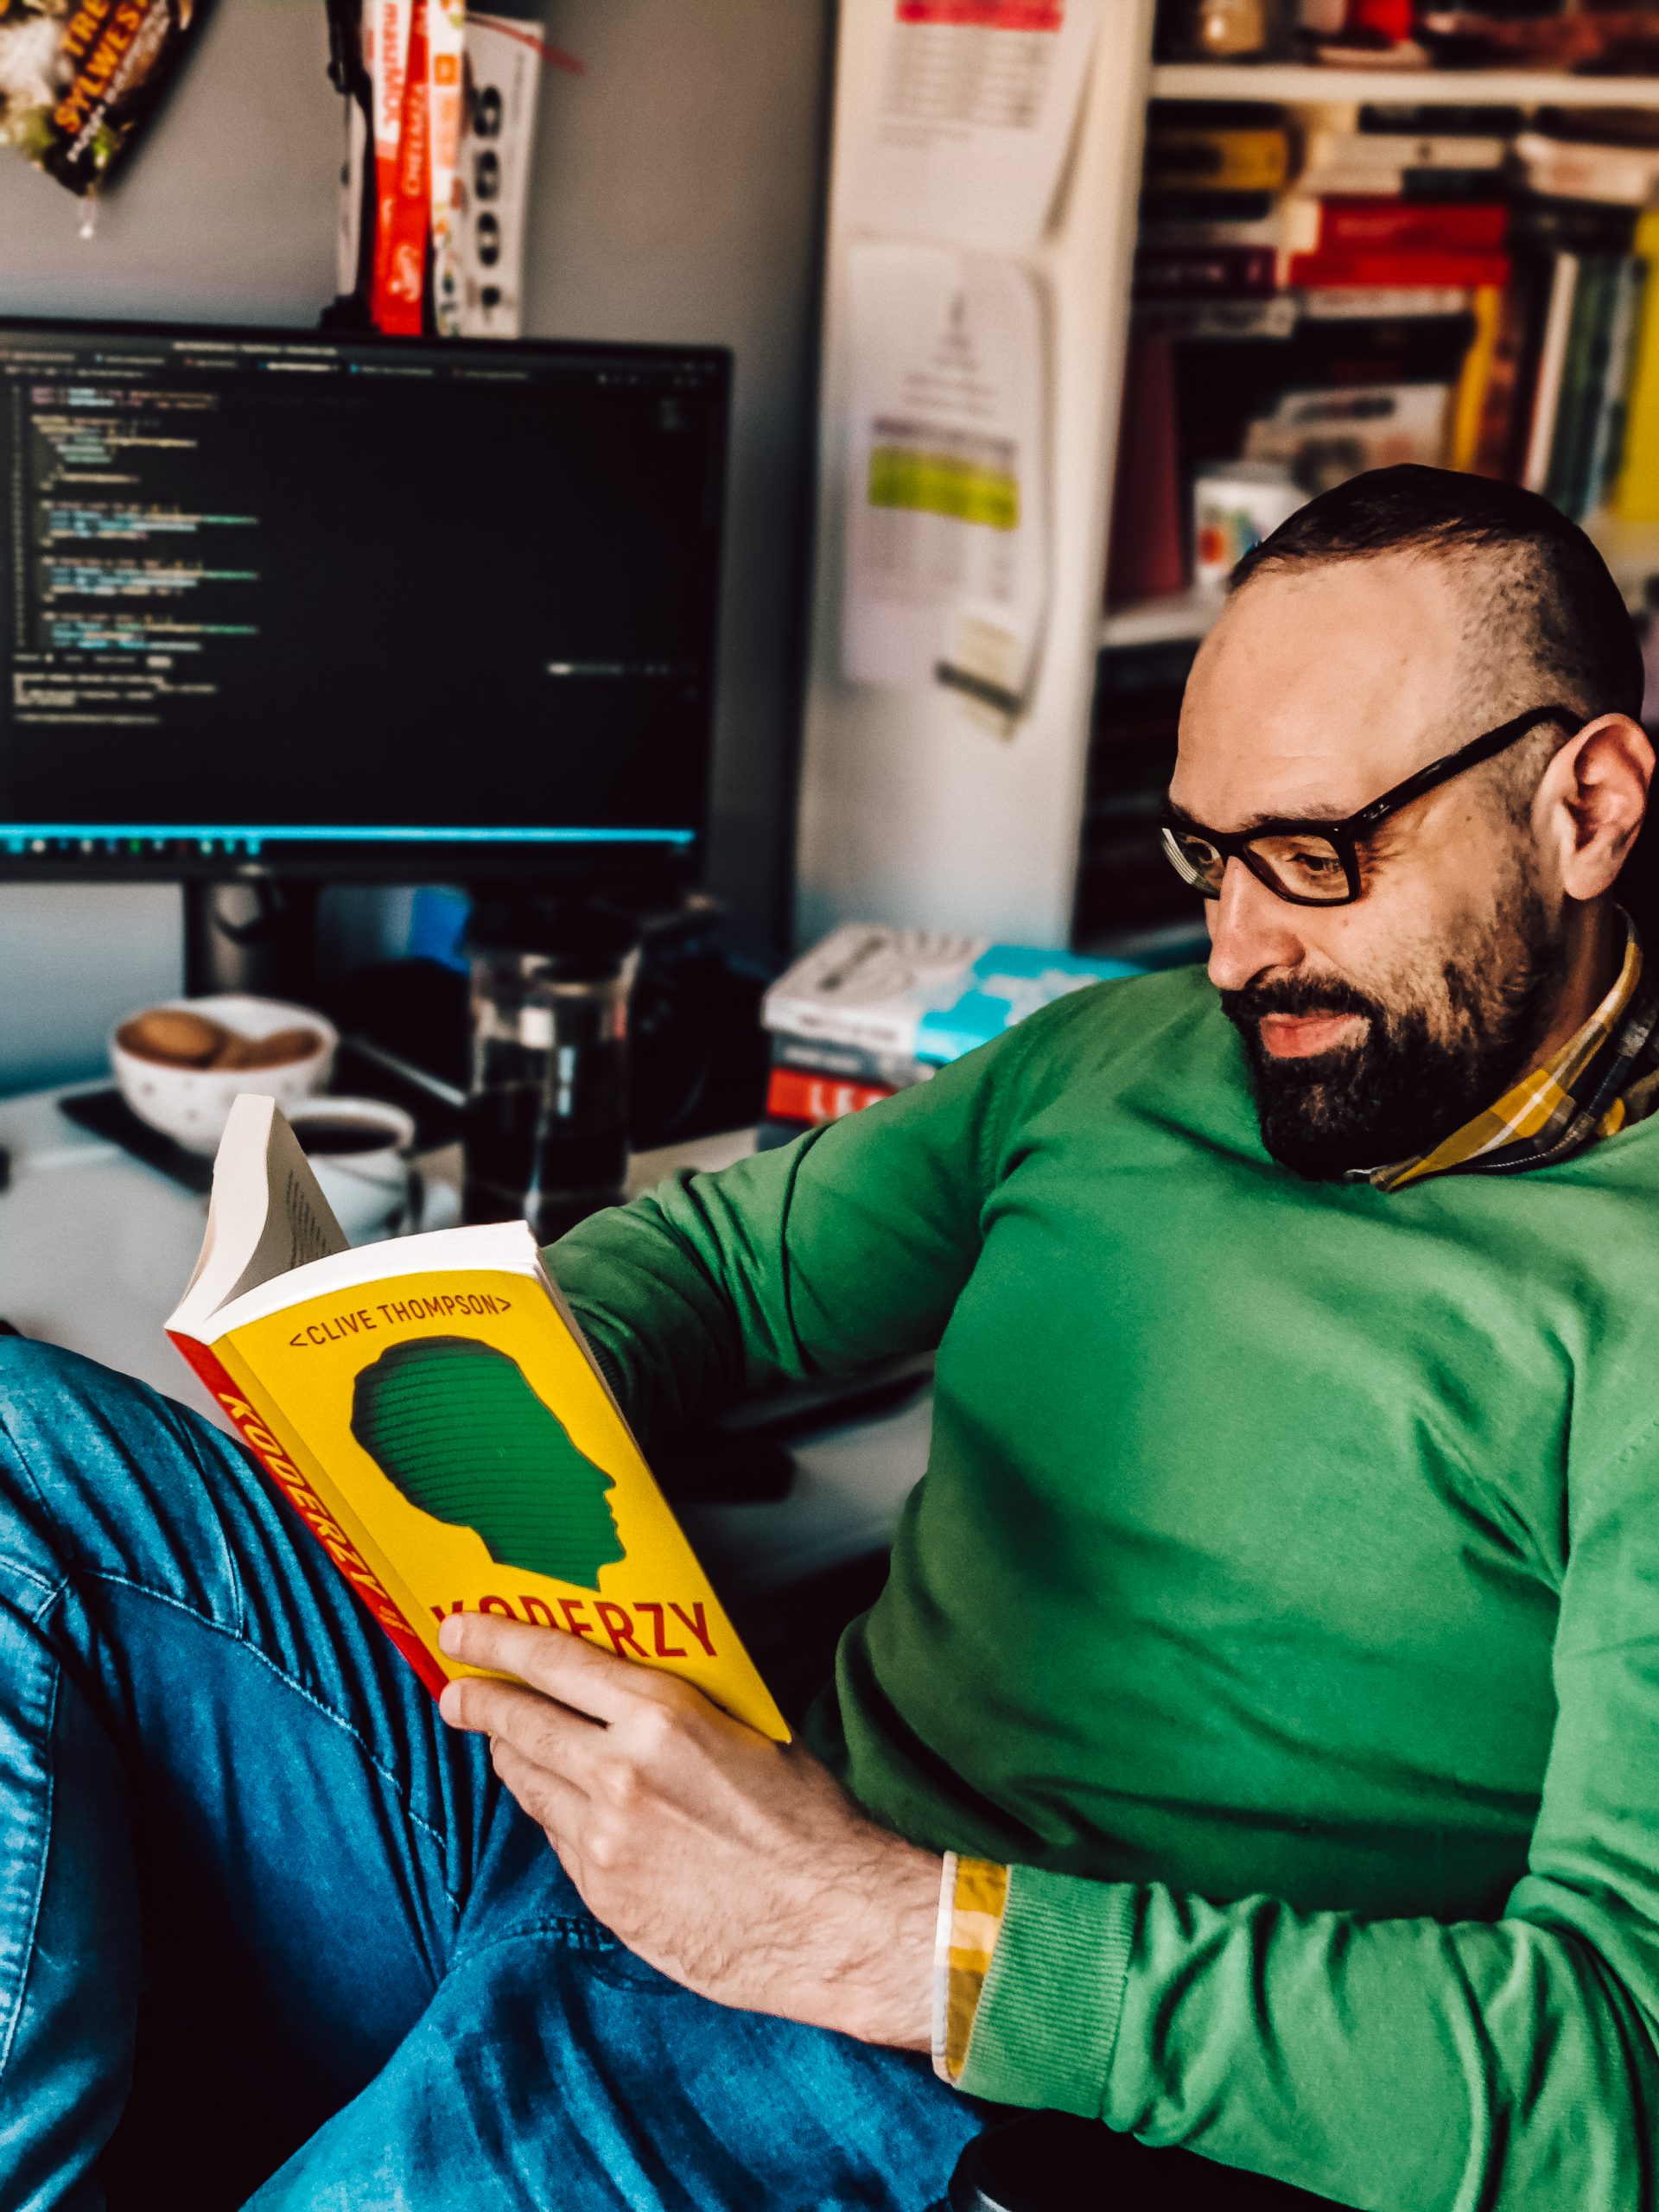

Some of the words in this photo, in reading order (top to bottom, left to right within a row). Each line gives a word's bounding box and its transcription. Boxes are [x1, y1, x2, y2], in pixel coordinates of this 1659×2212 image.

[54, 0, 149, 133] SYLWES
[218, 1392, 389, 1599] KODERZY
[429, 1595, 719, 1659] DERZY
